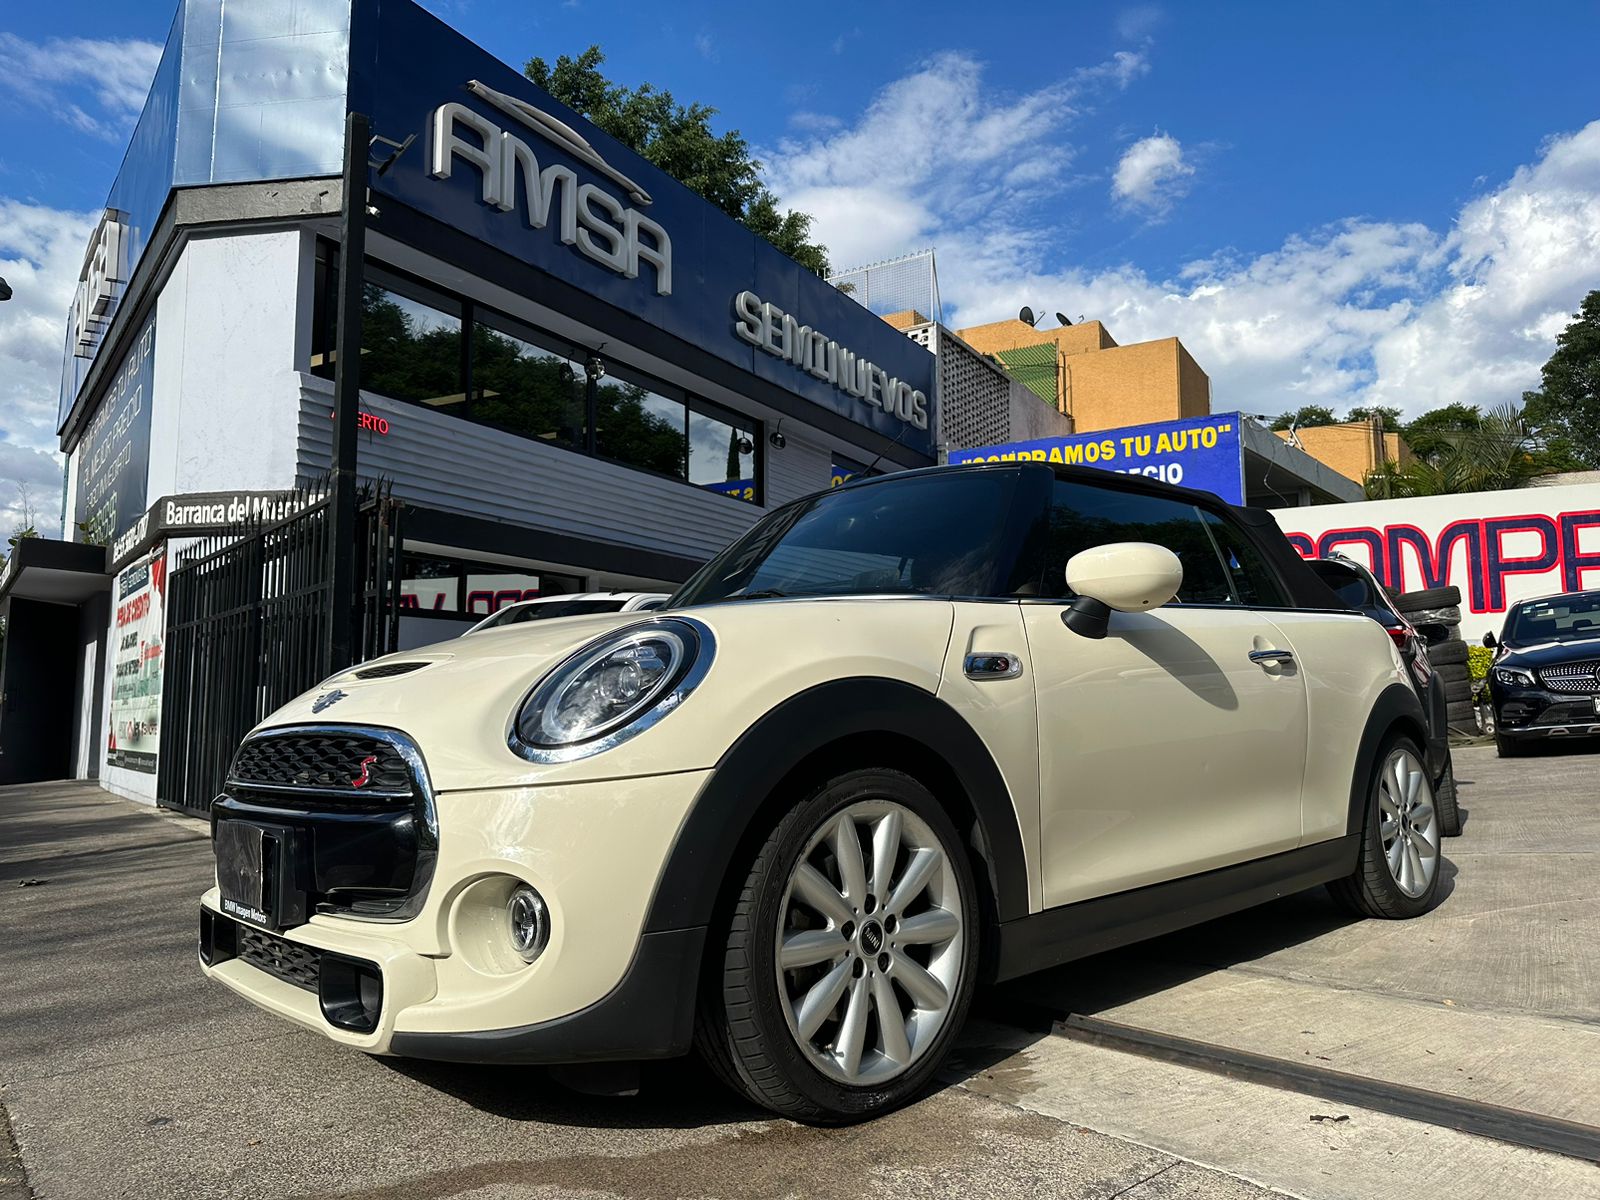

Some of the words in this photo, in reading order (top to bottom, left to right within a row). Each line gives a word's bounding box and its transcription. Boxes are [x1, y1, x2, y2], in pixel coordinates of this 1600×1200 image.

[433, 102, 672, 296] AMSA
[735, 290, 928, 430] SEMINUEVOS
[1120, 435, 1151, 457] TU
[1155, 424, 1231, 454] AUTO"
[166, 501, 224, 525] Barranca
[228, 495, 250, 523] del
[864, 927, 880, 949] MINI
